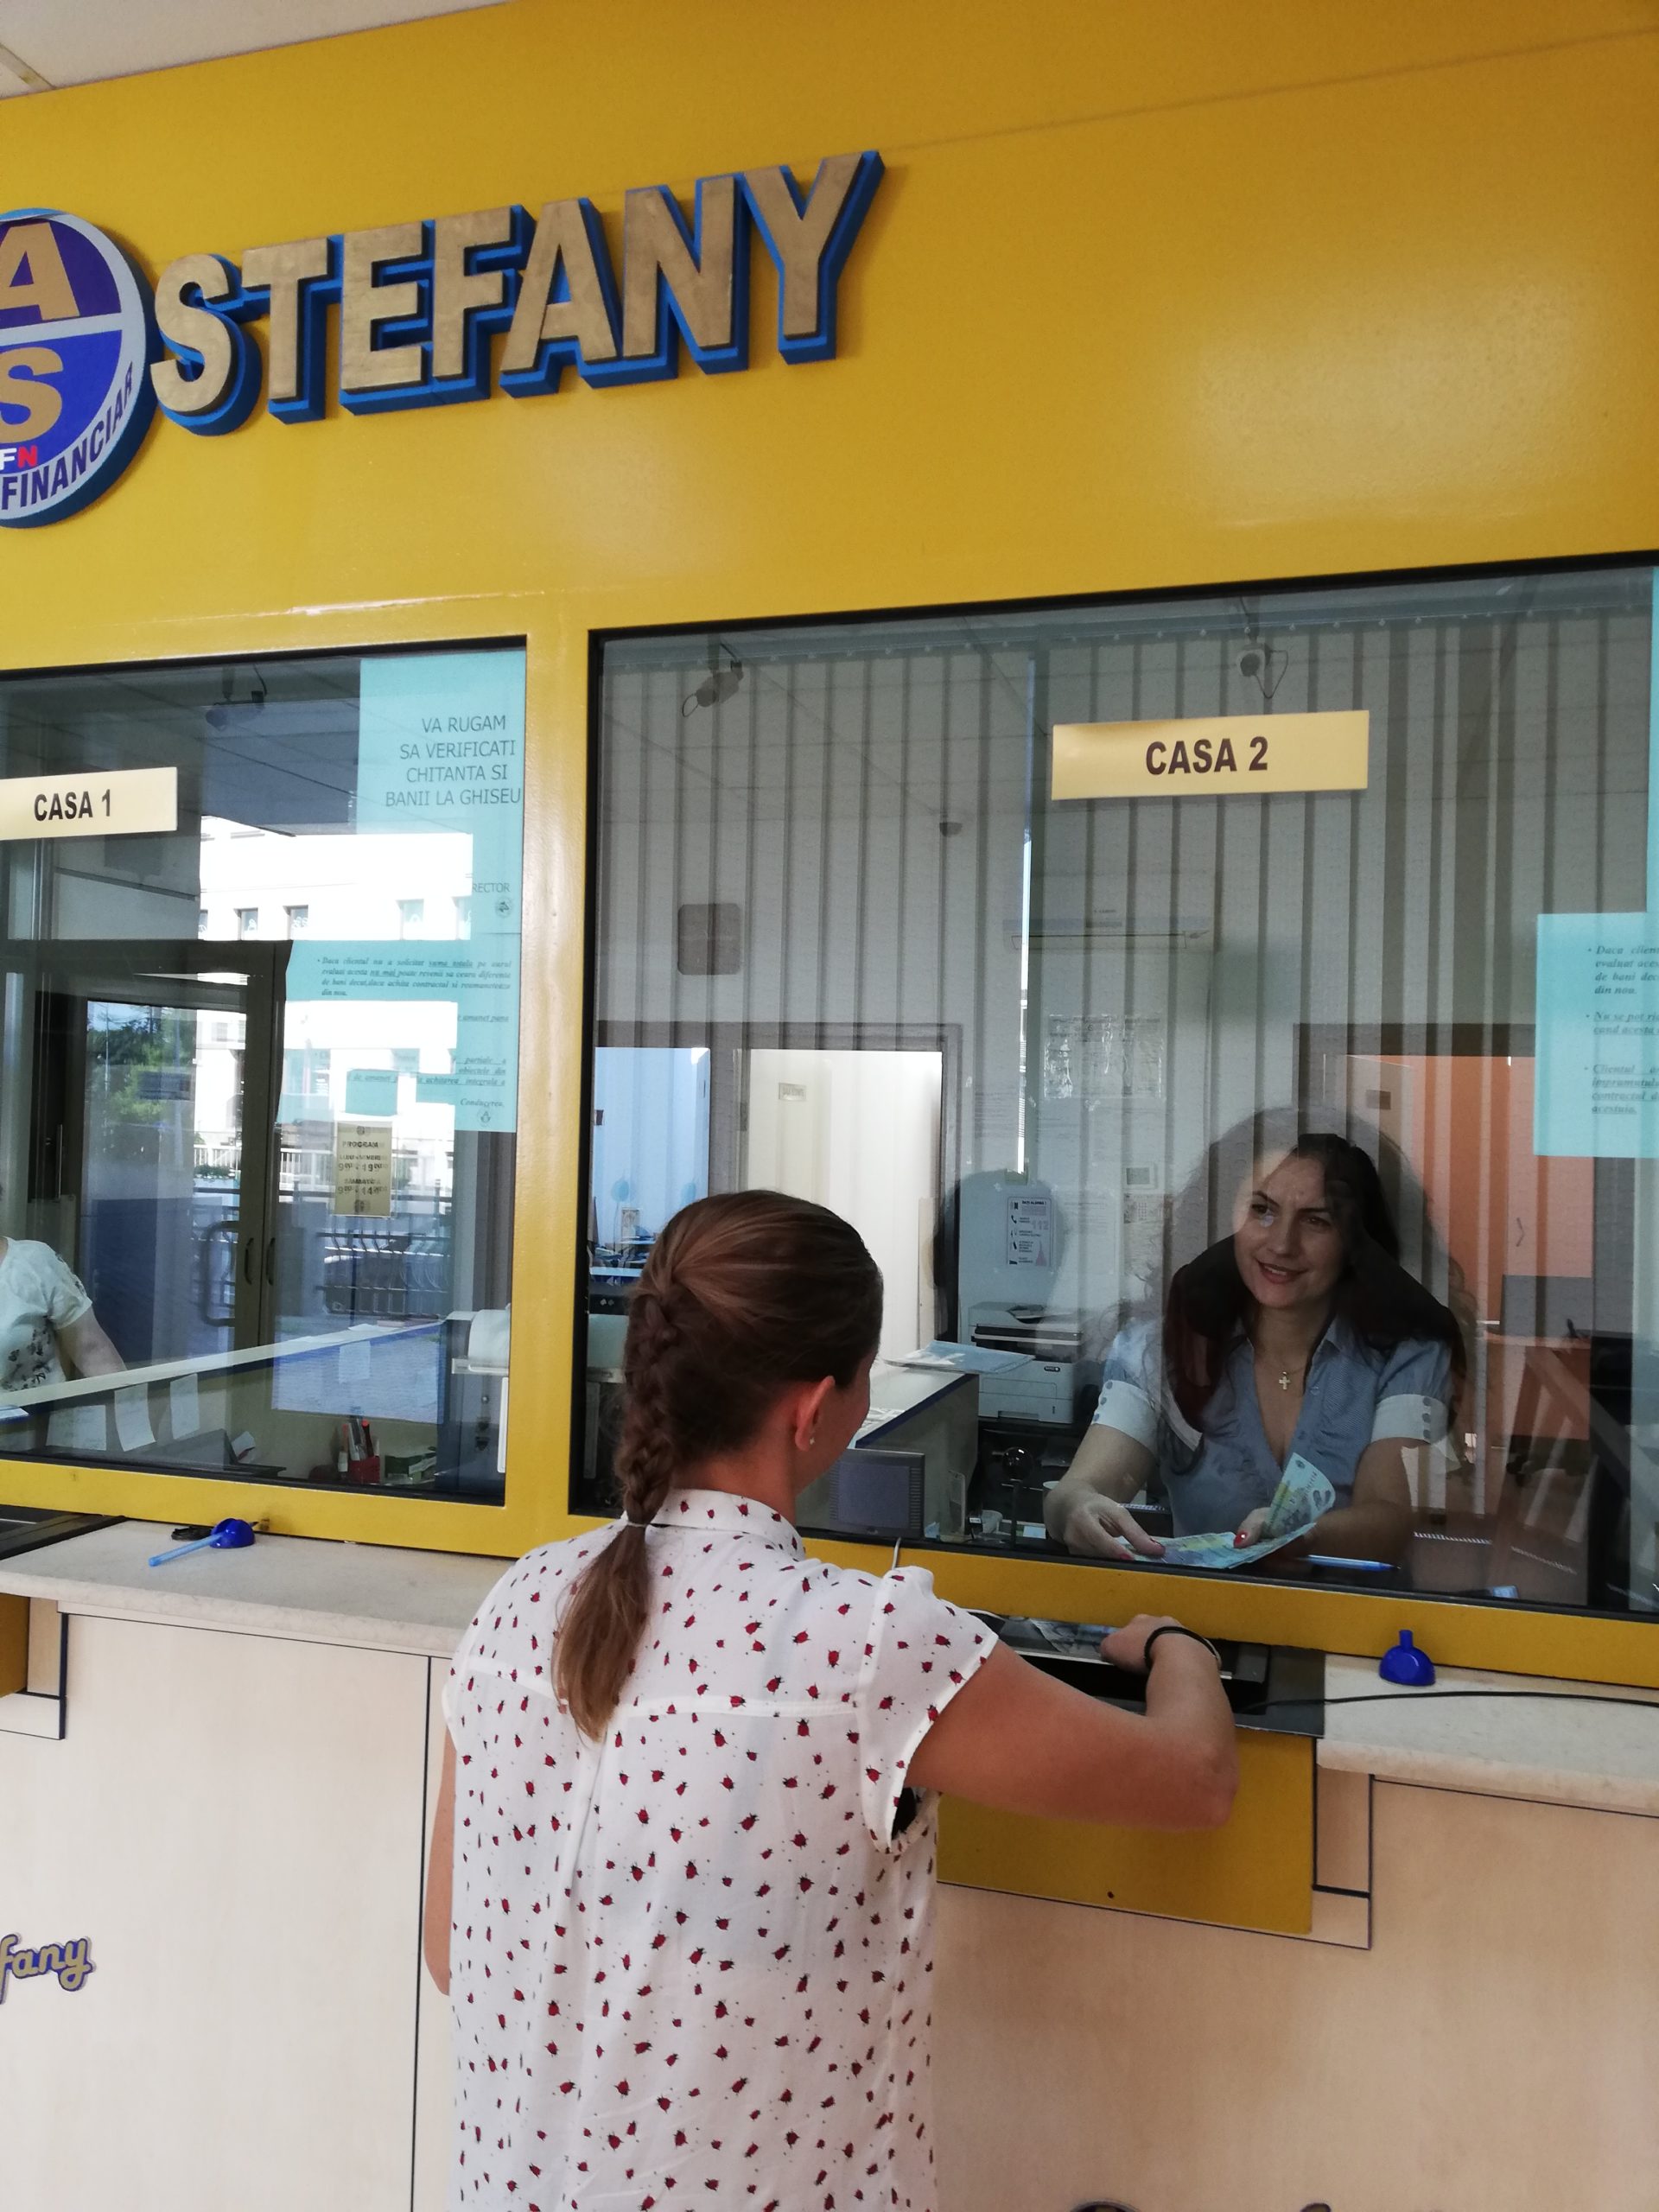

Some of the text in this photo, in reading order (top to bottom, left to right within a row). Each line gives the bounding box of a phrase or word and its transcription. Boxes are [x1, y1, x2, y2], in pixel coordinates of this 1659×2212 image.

[0, 221, 80, 321] A
[150, 149, 881, 435] STEFANY
[0, 346, 64, 443] S
[2, 360, 133, 511] FINANCIAR
[422, 715, 506, 733] VA RUGAM
[399, 740, 516, 760] SA VERIFICATI
[1146, 735, 1268, 776] CASA 2
[406, 764, 508, 783] CHITANTA SI
[34, 789, 111, 822] CASA 1
[385, 787, 521, 807] BANII LA GHISEU
[1596, 945, 1624, 955] Daca
[1595, 958, 1634, 968] evaluat
[1594, 972, 1608, 981] de
[1612, 972, 1636, 981] bani
[1594, 986, 1611, 995] din
